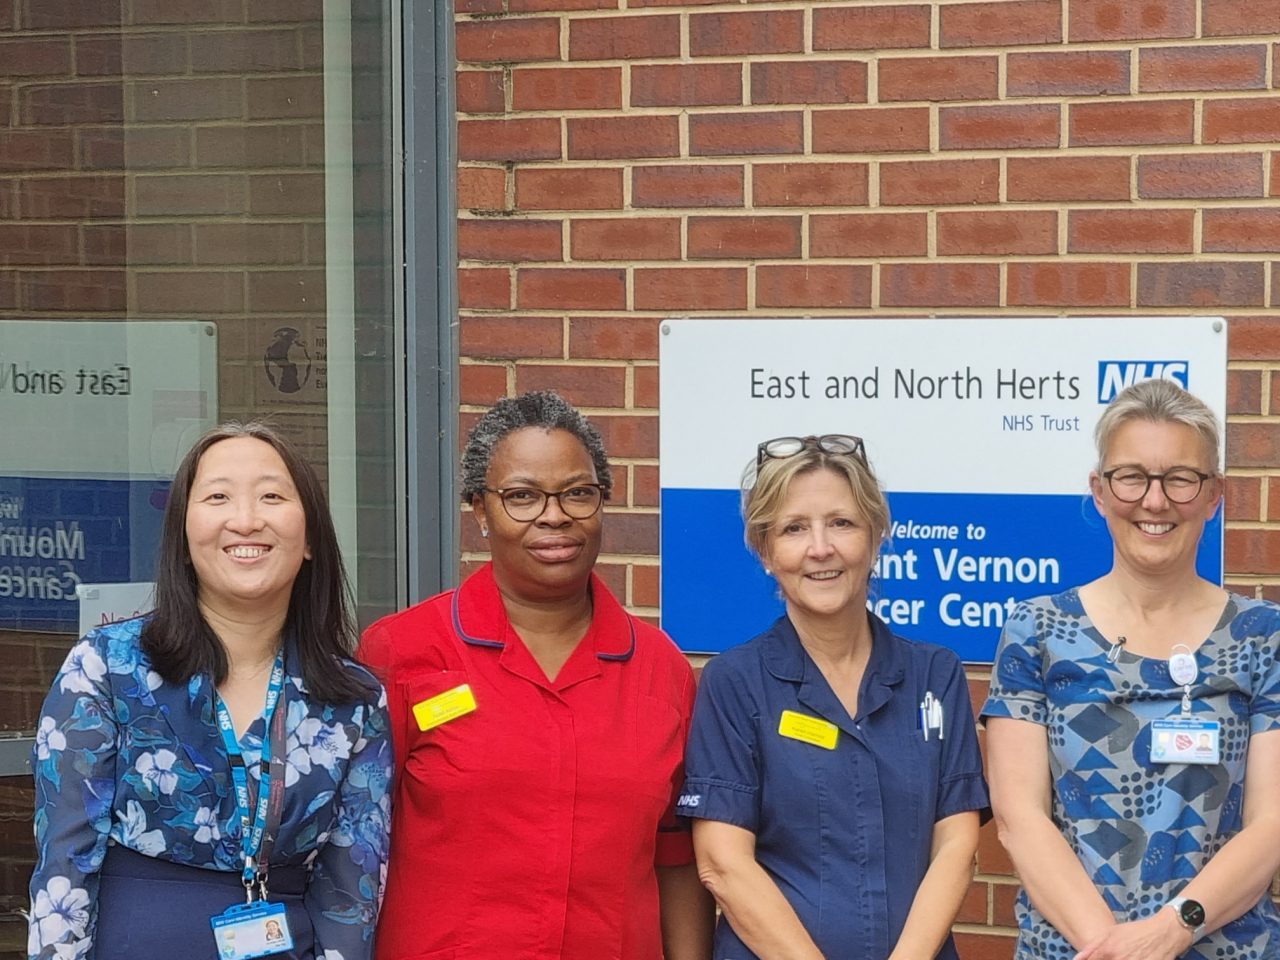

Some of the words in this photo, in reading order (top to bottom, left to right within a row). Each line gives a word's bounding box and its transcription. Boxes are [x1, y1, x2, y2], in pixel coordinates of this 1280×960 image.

[750, 368, 810, 398] East
[824, 366, 879, 398] and
[894, 367, 983, 399] North
[996, 368, 1080, 400] Herts
[1002, 414, 1033, 431] NHS
[1040, 415, 1080, 432] Trust
[966, 523, 986, 540] to
[933, 548, 1060, 584] Vernon
[218, 710, 233, 731] NHS
[677, 795, 701, 806] NHS
